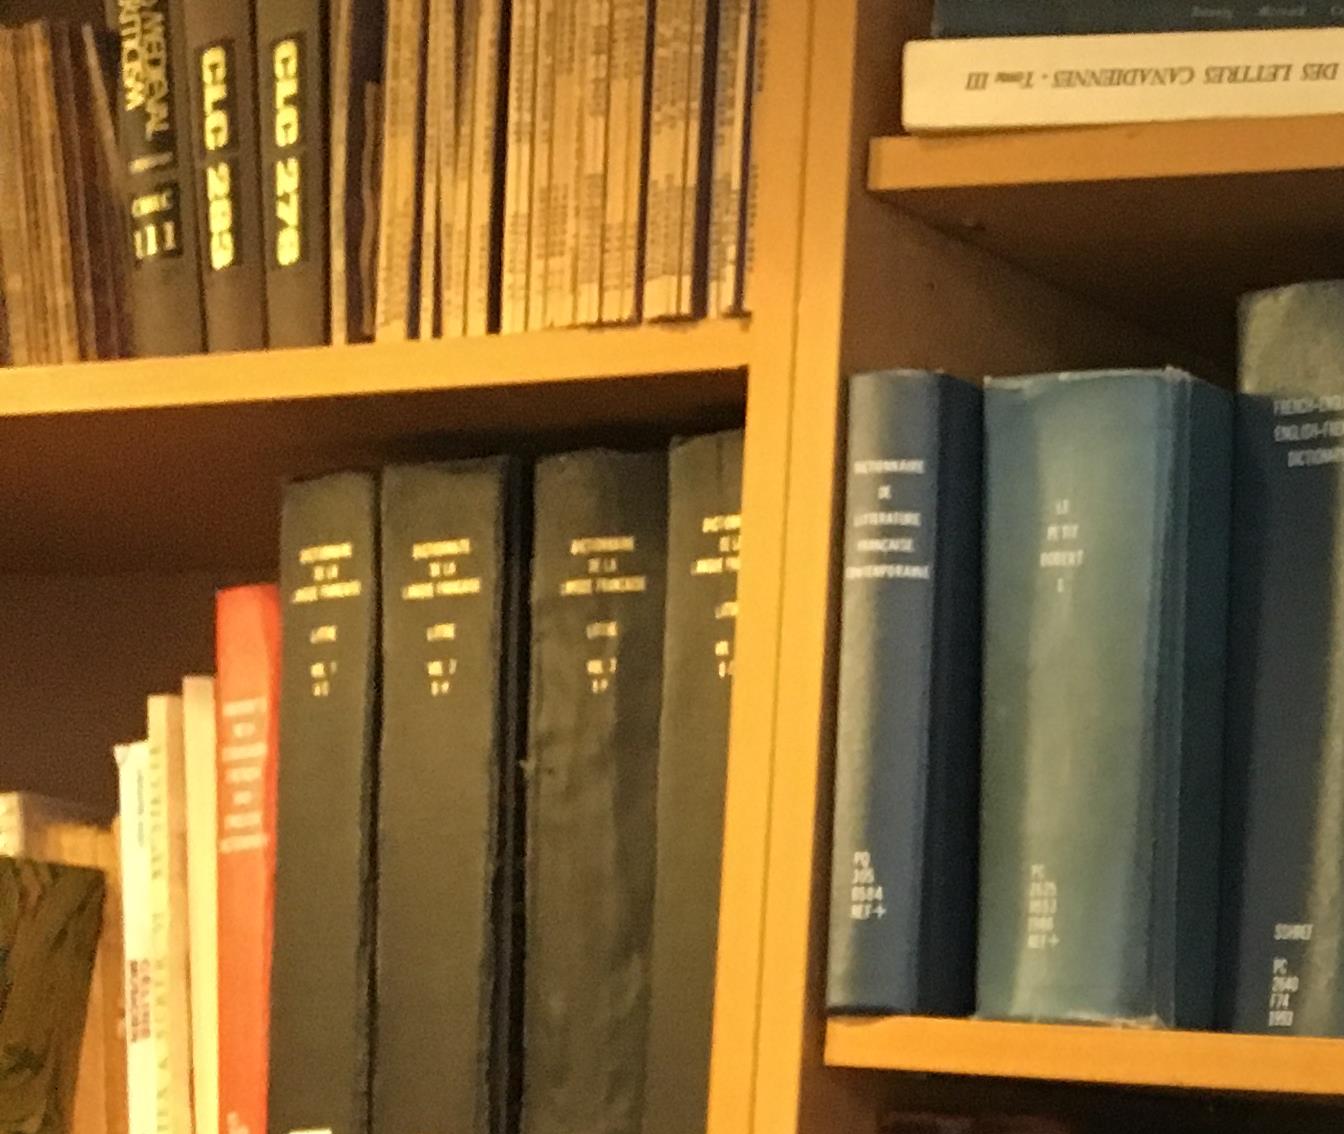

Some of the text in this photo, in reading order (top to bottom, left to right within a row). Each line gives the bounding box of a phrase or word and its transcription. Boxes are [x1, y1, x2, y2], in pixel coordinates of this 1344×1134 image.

[1051, 65, 1196, 88] CANADIENNES
[1204, 62, 1292, 85] LETTRES
[1300, 61, 1338, 82] DES
[203, 46, 229, 150] CLC
[273, 40, 298, 148] CLC
